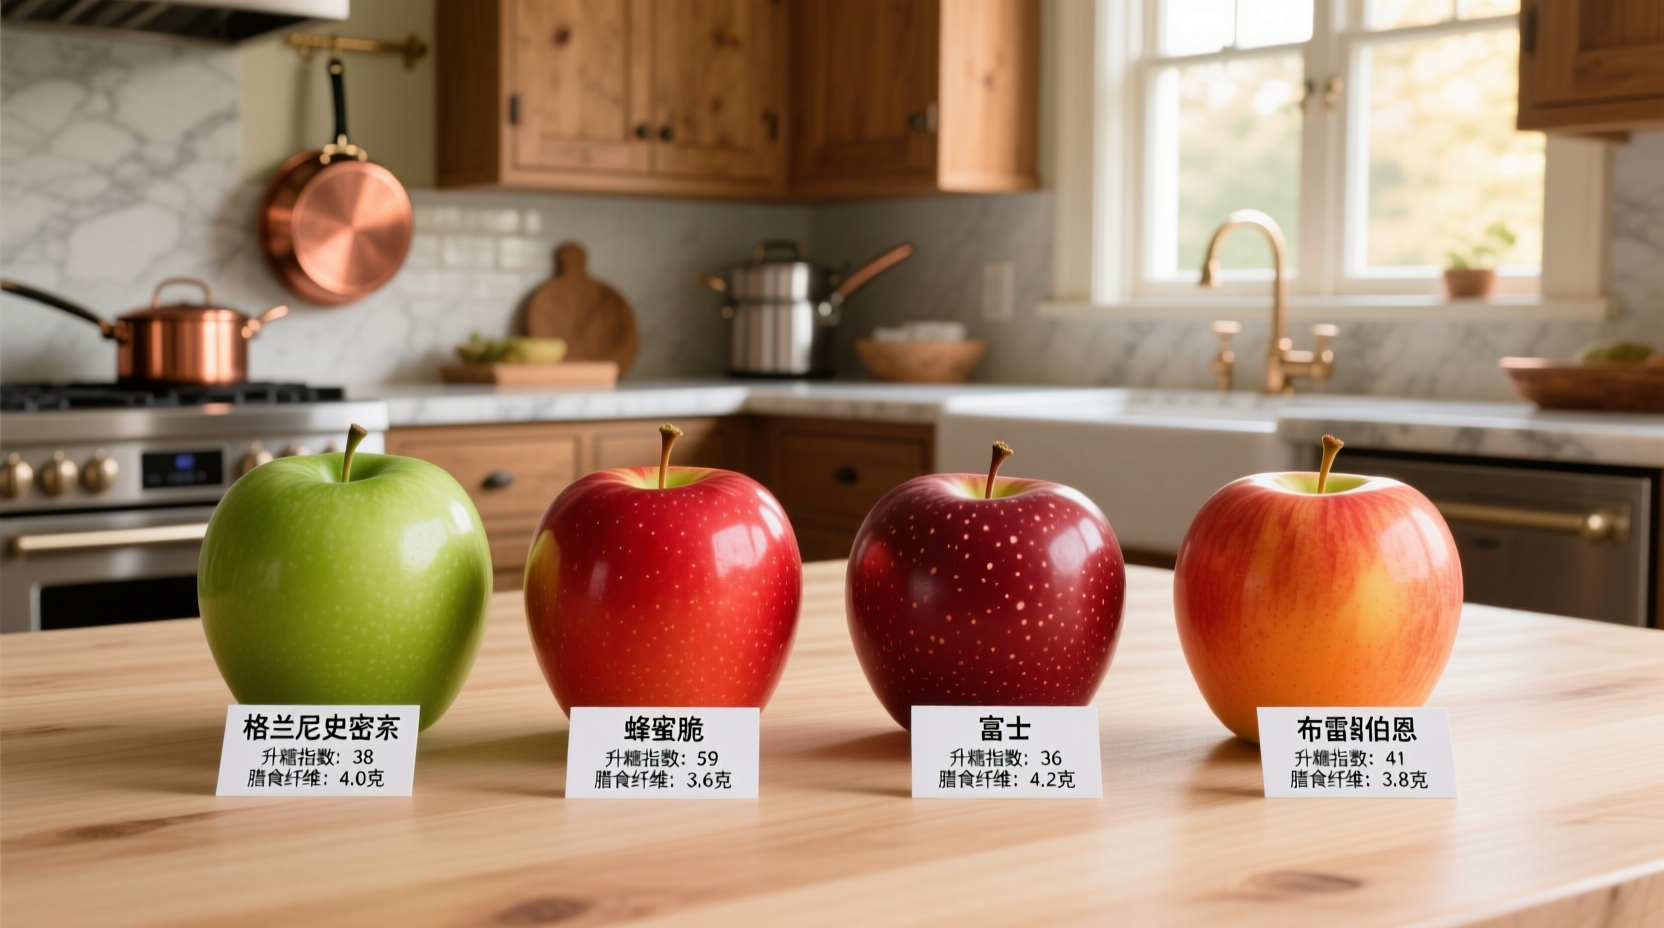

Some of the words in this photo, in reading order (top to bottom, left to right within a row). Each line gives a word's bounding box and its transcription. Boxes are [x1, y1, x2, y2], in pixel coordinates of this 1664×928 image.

[623, 714, 704, 743] 蜂蜜脆
[979, 714, 1031, 742] 富士
